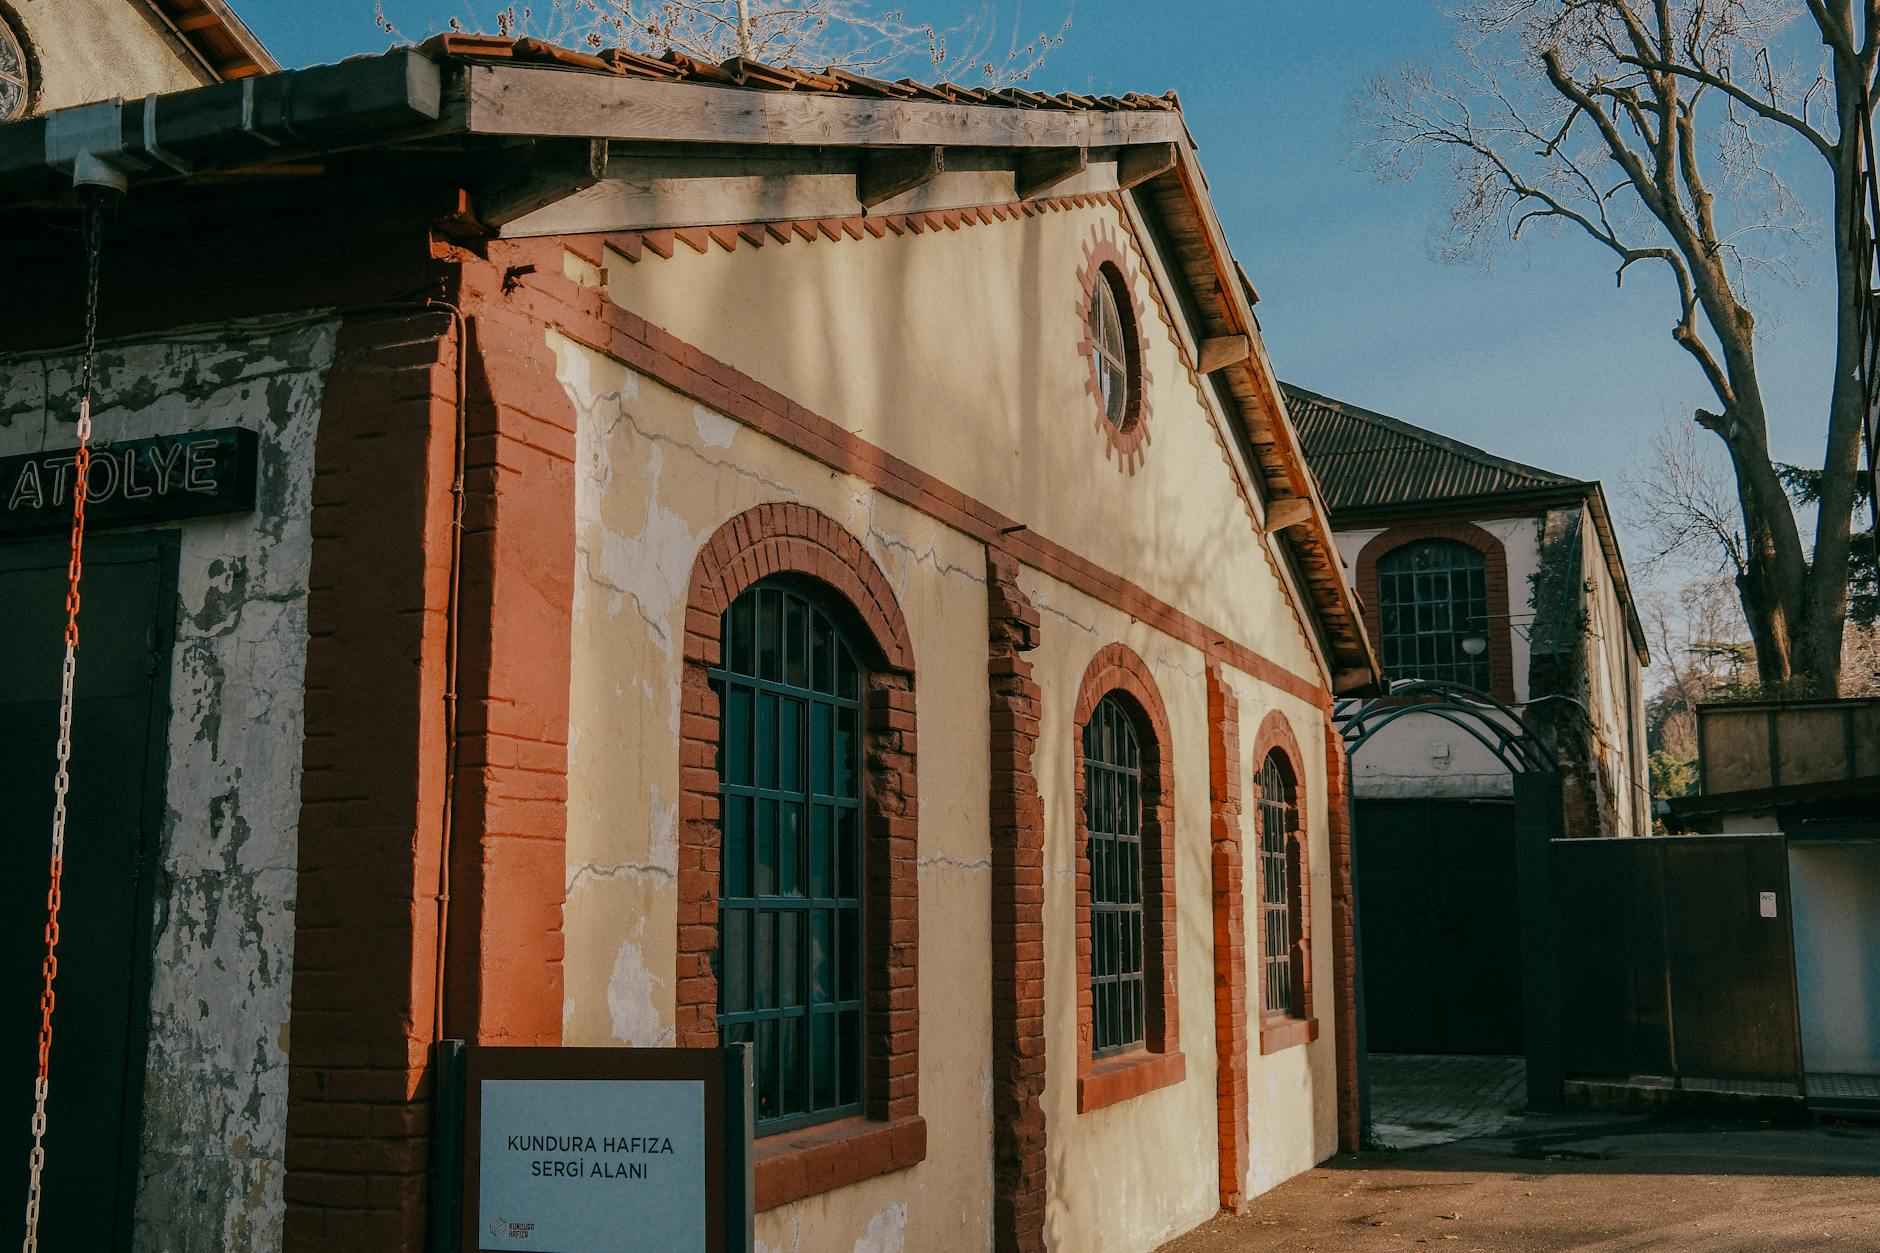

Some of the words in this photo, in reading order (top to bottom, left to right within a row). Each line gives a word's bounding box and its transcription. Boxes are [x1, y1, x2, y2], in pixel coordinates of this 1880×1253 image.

[8, 439, 219, 510] ATÖLYE
[507, 1135, 597, 1153] KUNDURA
[603, 1137, 674, 1154] HAFIZA
[531, 1158, 584, 1177] SERGİ
[590, 1162, 648, 1179] ALANI
